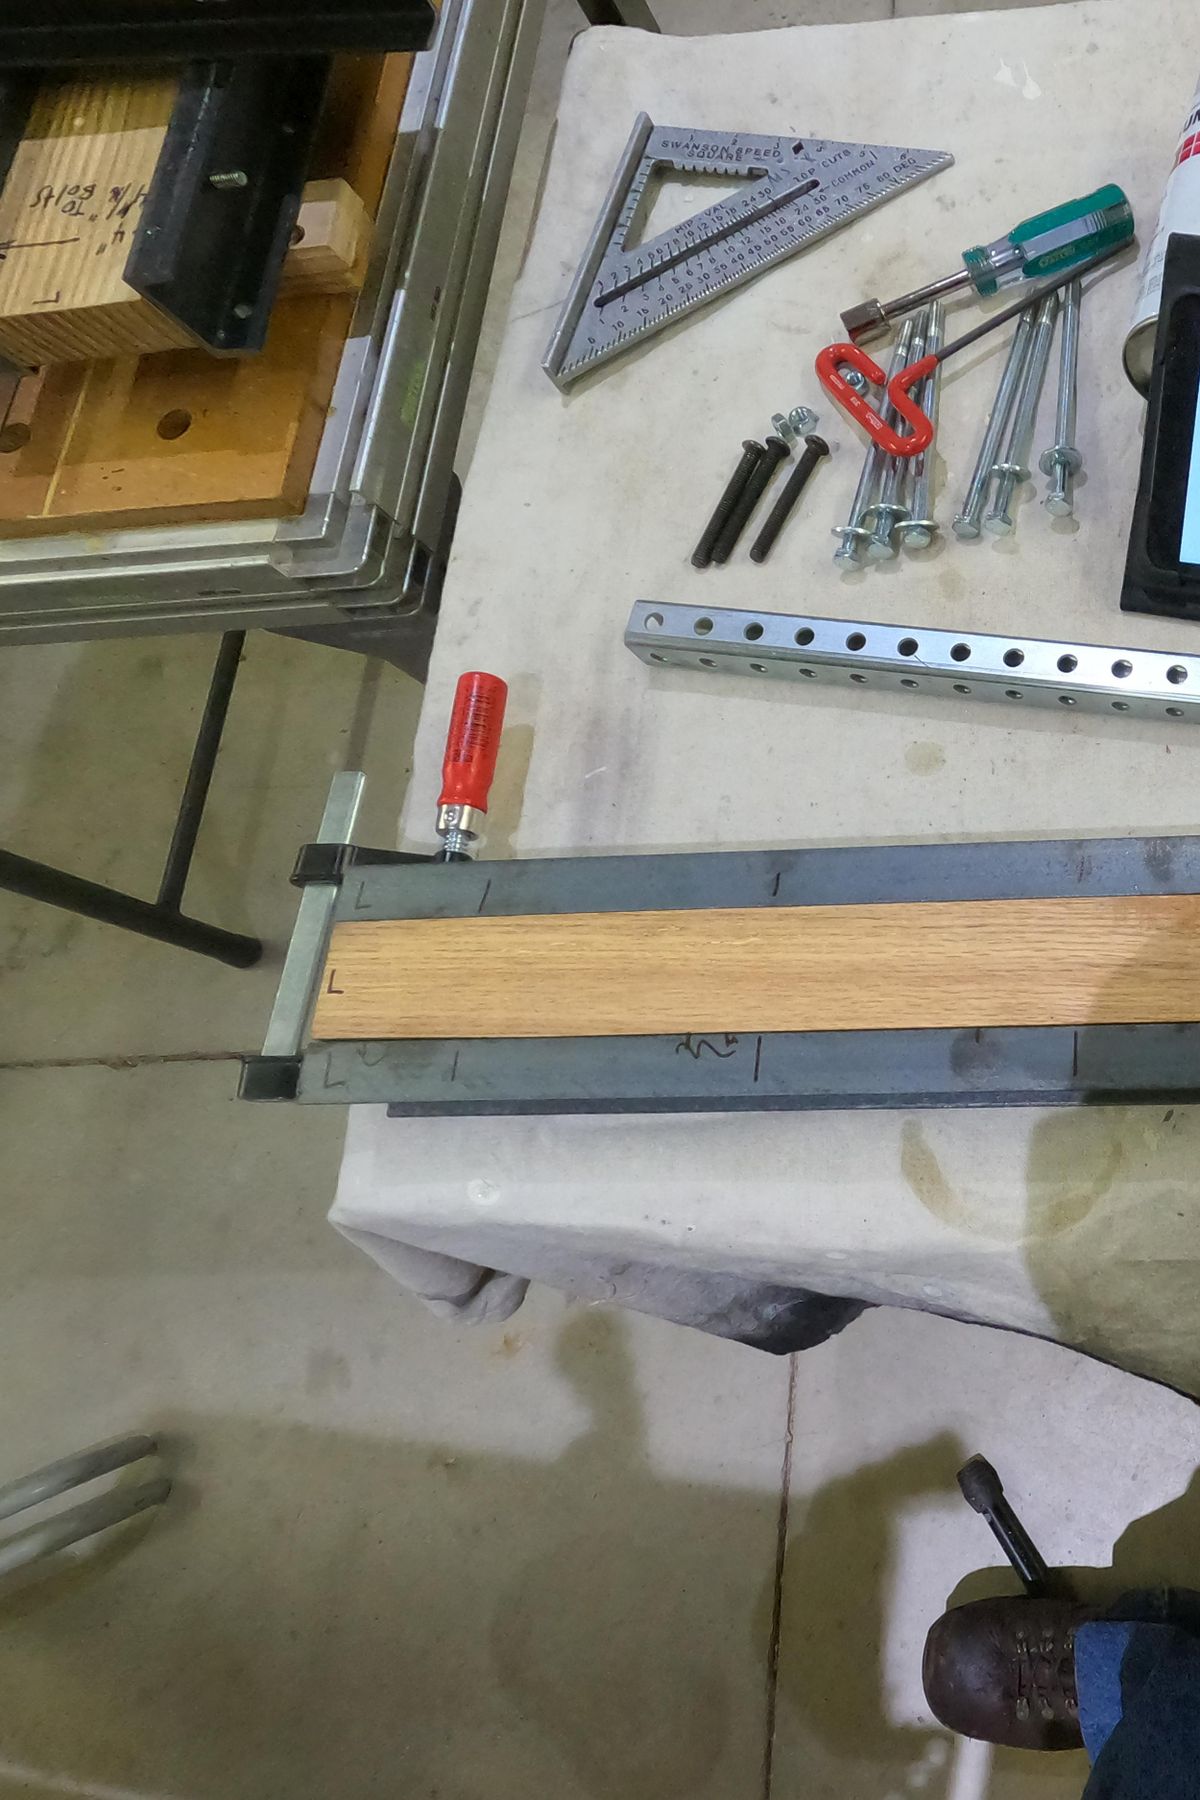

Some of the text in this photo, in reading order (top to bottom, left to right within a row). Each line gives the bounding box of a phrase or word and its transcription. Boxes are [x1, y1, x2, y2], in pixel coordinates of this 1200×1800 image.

[661, 139, 730, 154] SWANSON
[735, 146, 782, 158] SPEED
[687, 149, 743, 162] SQUARE
[830, 159, 875, 188] COMMON
[893, 157, 917, 174] DEG
[353, 880, 372, 910] L
[326, 968, 345, 995] L
[323, 1051, 347, 1089] L
